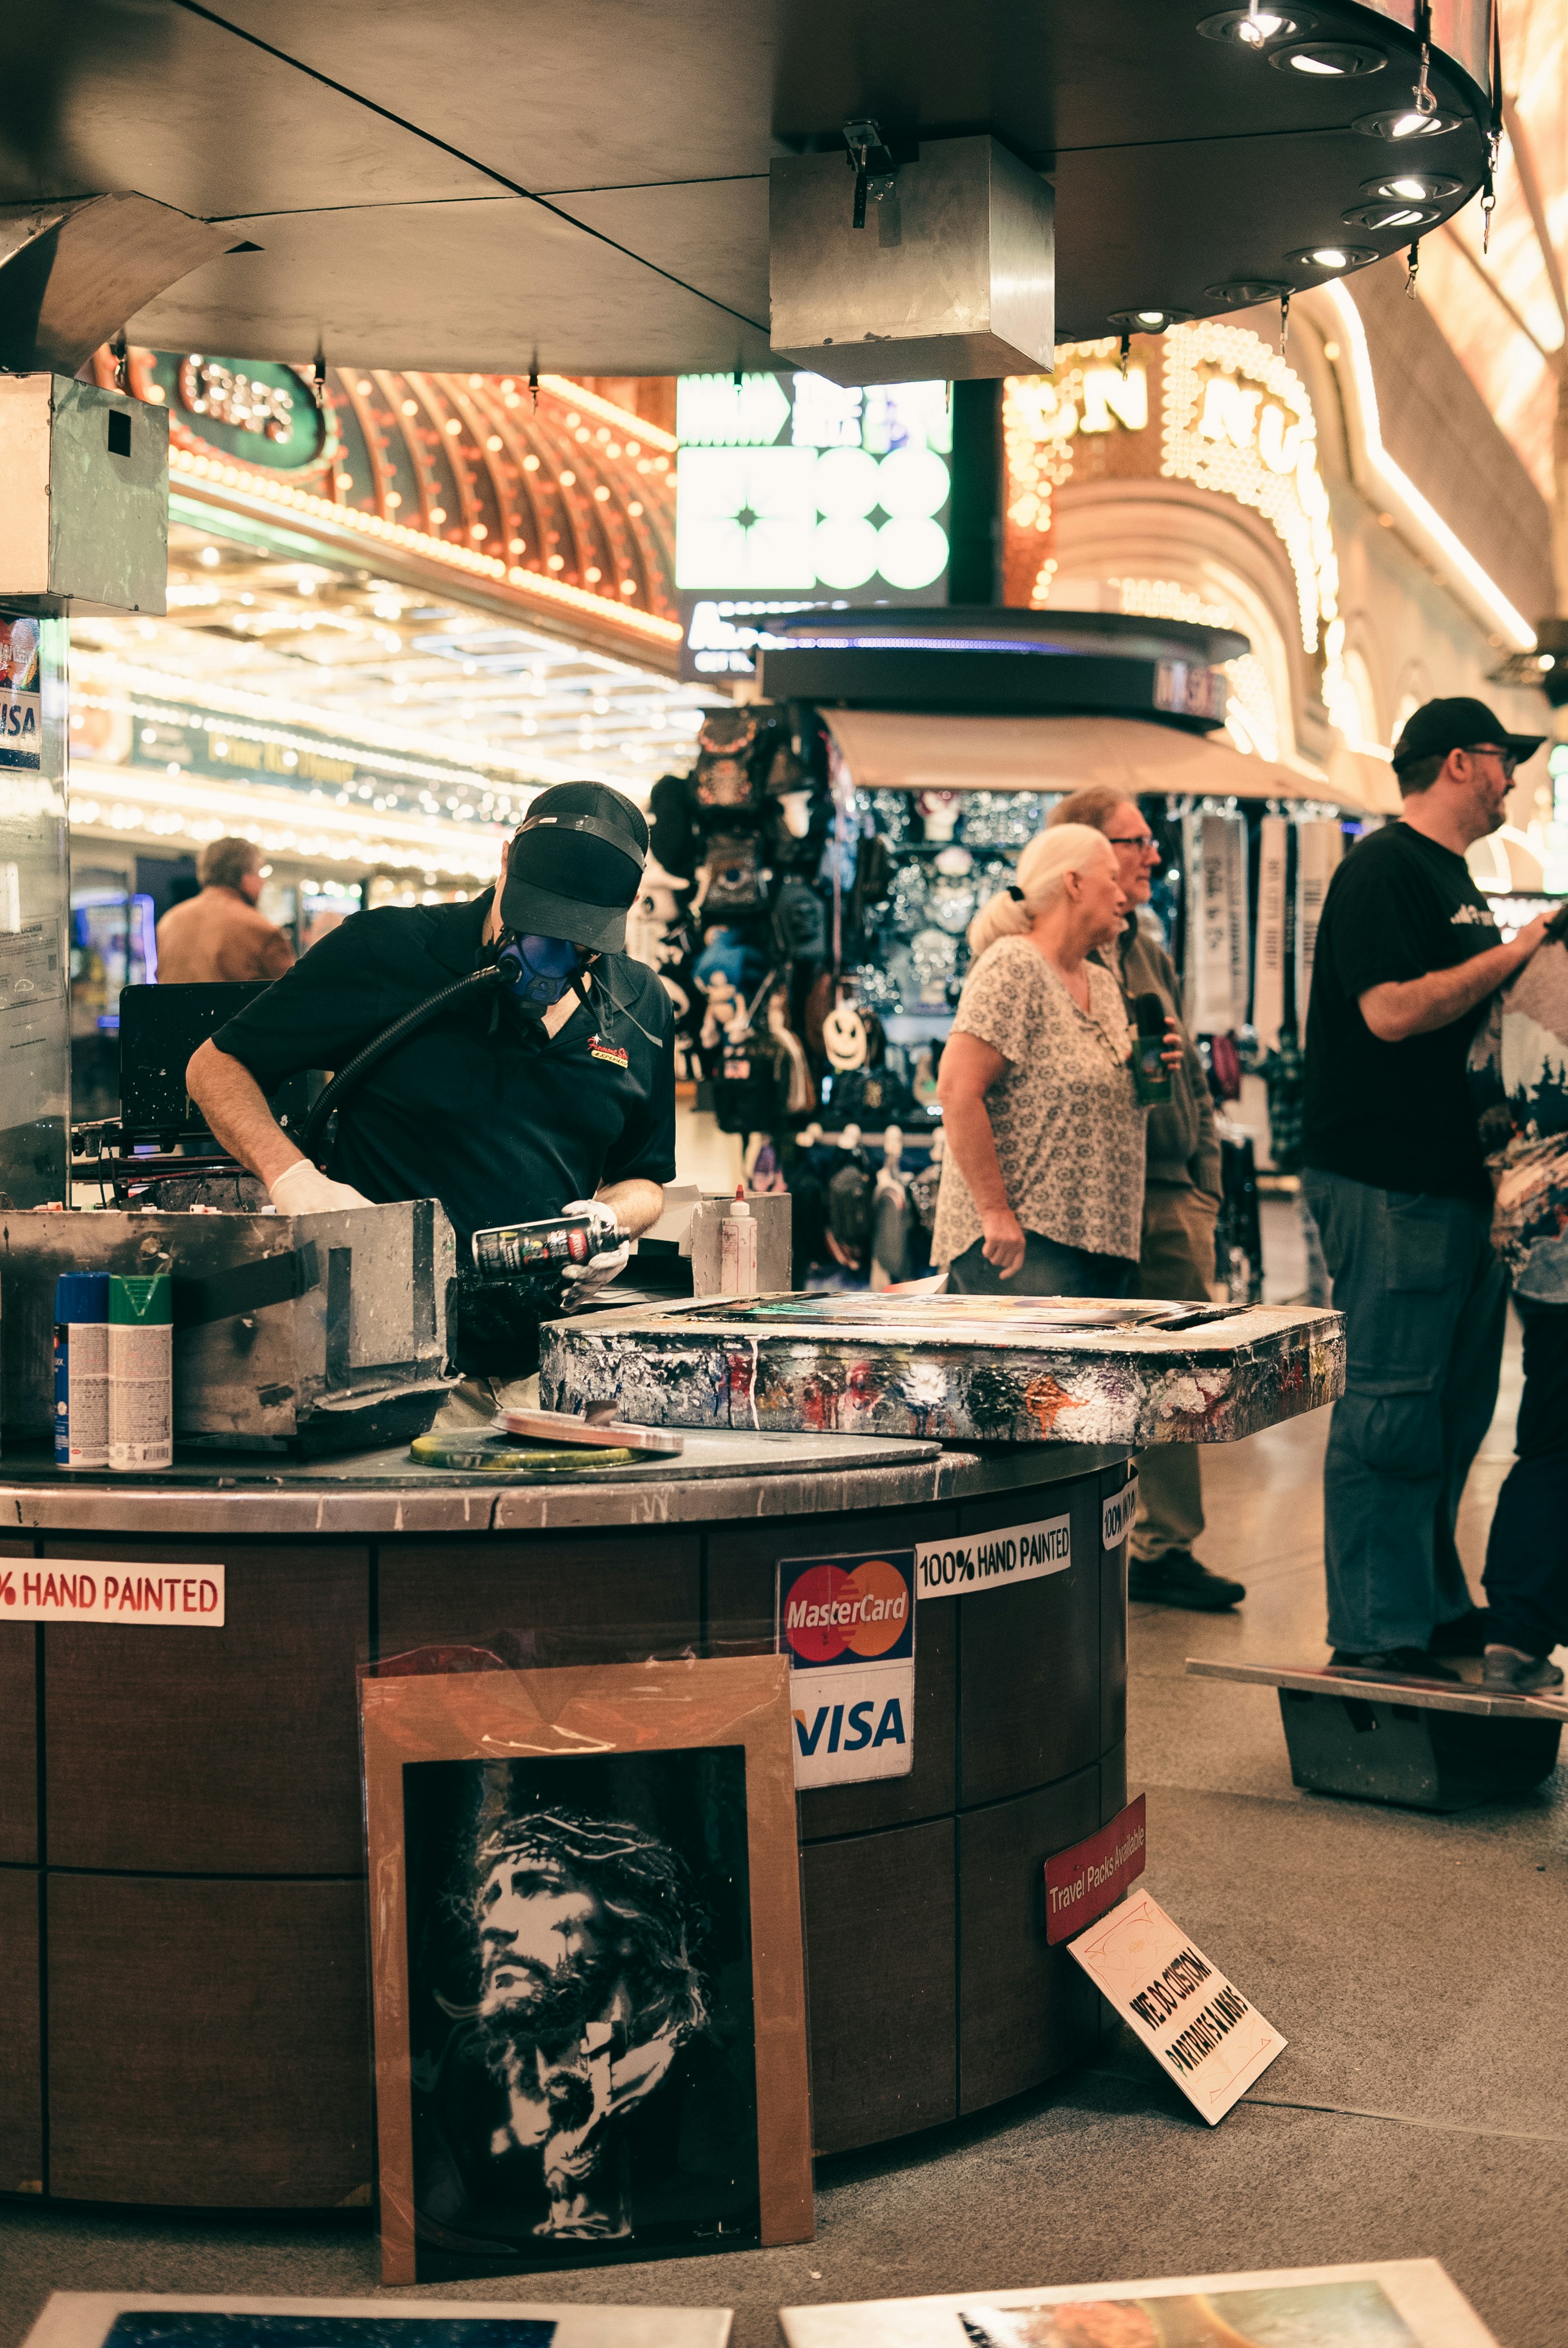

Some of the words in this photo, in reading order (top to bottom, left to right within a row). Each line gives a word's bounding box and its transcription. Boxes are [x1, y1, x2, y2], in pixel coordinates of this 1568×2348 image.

[0, 703, 35, 736] ISA
[919, 1547, 975, 1587] 100%
[978, 1539, 1016, 1577] HAND
[1020, 1527, 1069, 1568] PAINTED
[23, 1572, 97, 1609] HAND
[104, 1576, 218, 1612] PAINTED
[787, 1591, 906, 1630] MasterCard
[791, 1698, 906, 1757] VISA
[1049, 1870, 1085, 1914] Travel
[1087, 1855, 1114, 1893] Packs
[1114, 1824, 1145, 1872] Available
[1162, 1946, 1212, 2001] CUSTOM
[1129, 1991, 1167, 2031] WE
[1146, 1979, 1179, 2016] DO
[1164, 2012, 1223, 2078] PORTRAITS
